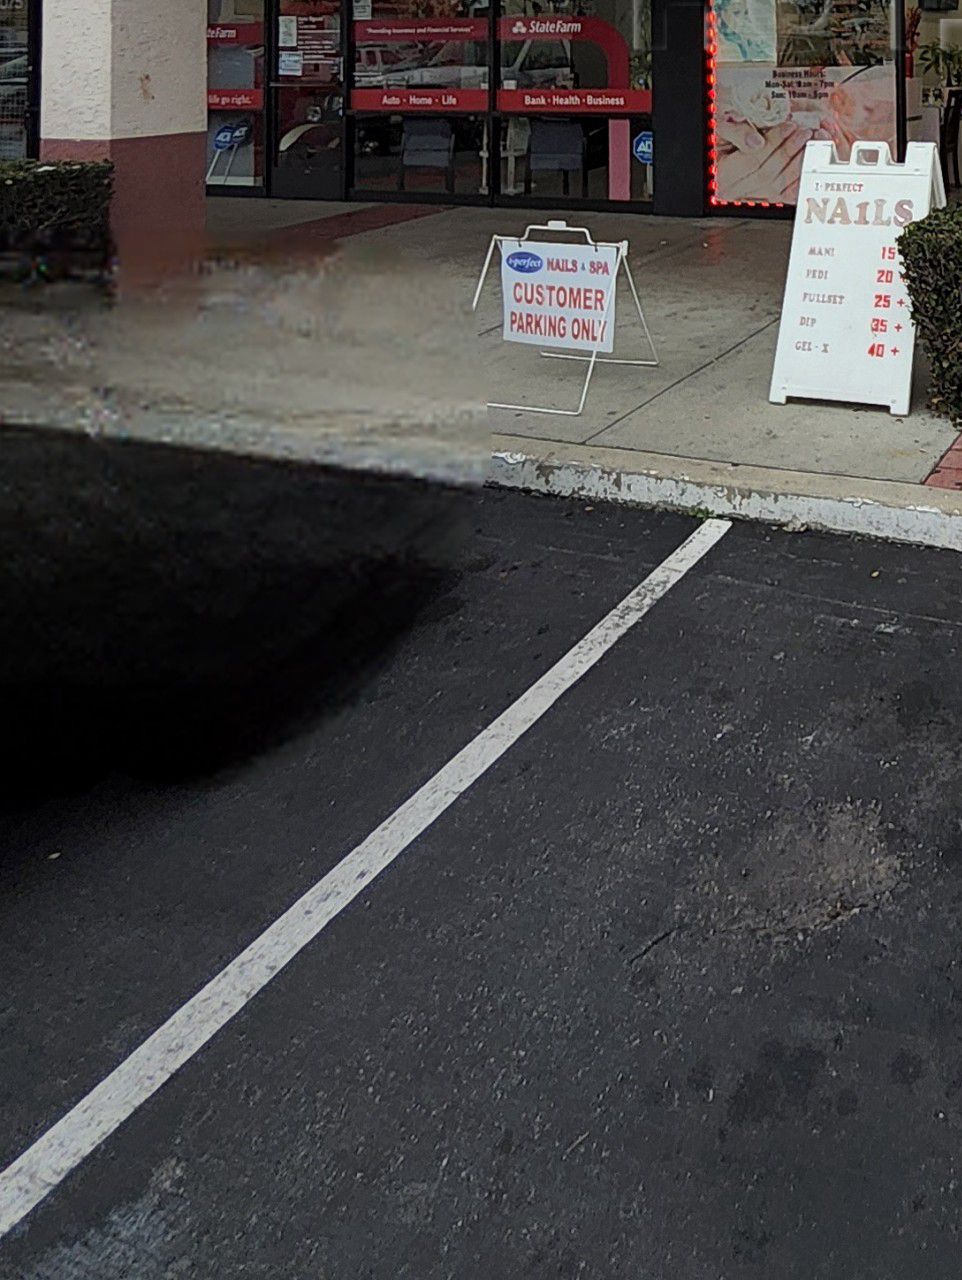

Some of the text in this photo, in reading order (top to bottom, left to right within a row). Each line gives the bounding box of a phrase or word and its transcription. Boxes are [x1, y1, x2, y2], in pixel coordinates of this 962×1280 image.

[382, 94, 457, 105] Auto Home Life
[524, 95, 624, 105] Bank Health Business
[808, 246, 896, 260] MANI 15
[546, 257, 578, 273] NAILS
[589, 260, 610, 276] SPA
[806, 268, 828, 280] PEDI
[876, 270, 893, 283] 20
[513, 282, 605, 311] CUSTOMER
[802, 292, 845, 305] FULLSET
[874, 294, 891, 308] 25
[510, 311, 607, 343] PARKING ONLY
[799, 316, 816, 327] DIP
[871, 318, 887, 332] 35
[868, 343, 884, 357] 40
